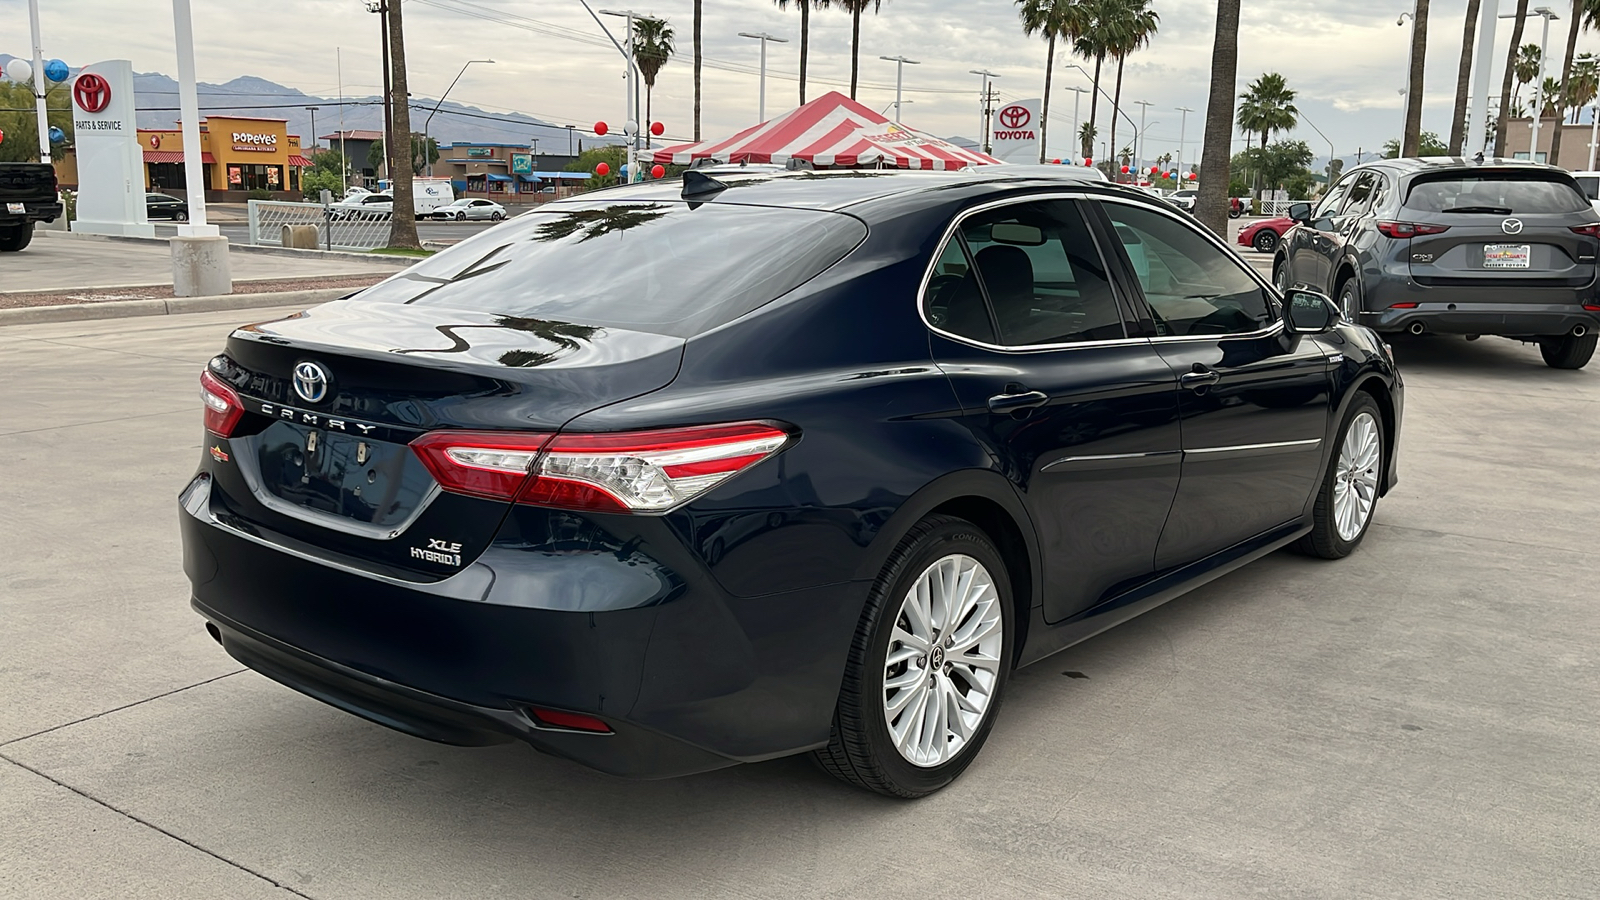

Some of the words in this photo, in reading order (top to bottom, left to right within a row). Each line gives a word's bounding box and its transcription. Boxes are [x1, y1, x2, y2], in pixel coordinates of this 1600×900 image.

[75, 120, 91, 130] PARTS
[92, 120, 96, 130] &
[97, 120, 122, 131] SERVICE
[993, 130, 1036, 140] TOYOTA
[261, 403, 377, 434] CAMRY
[427, 538, 463, 553] XLE
[410, 546, 453, 565] HYBRID
